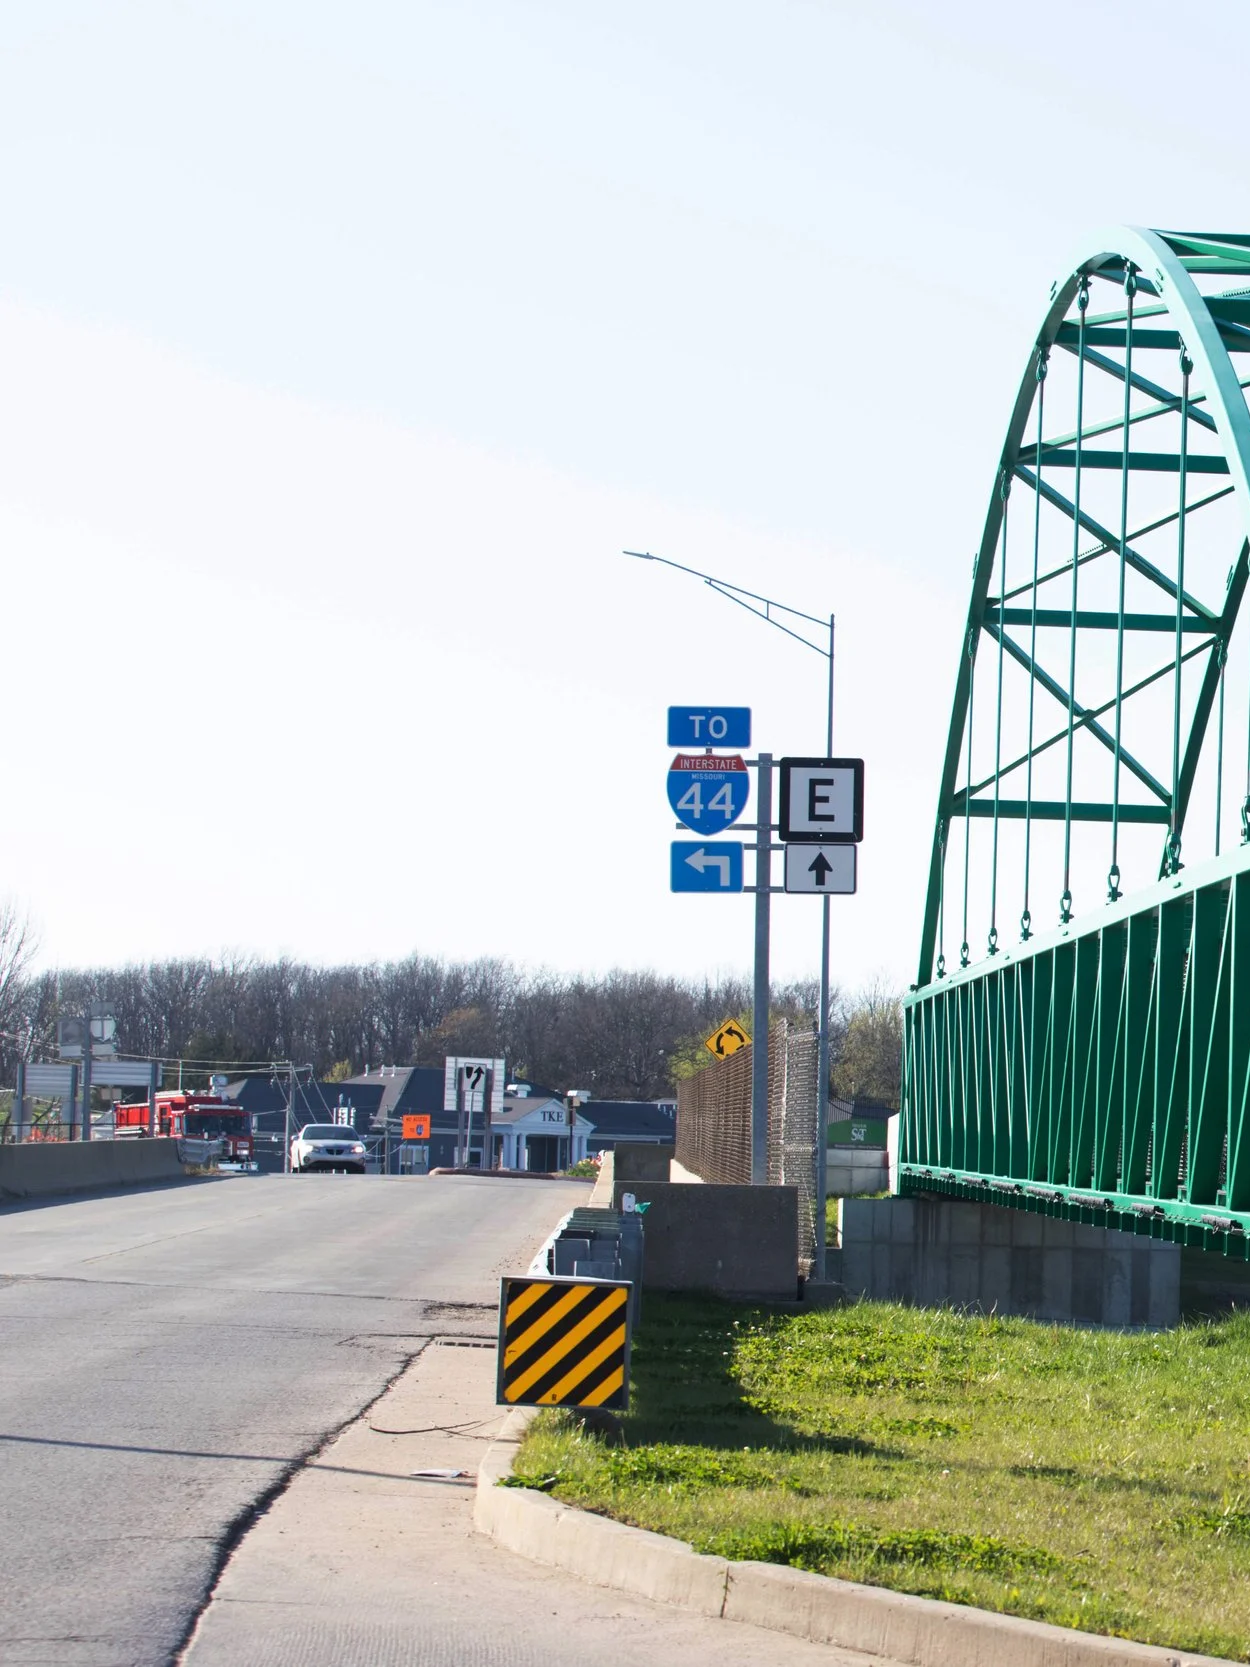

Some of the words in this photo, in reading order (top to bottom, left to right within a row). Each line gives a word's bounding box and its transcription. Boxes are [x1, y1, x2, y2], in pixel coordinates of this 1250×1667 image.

[689, 715, 728, 739] TO
[680, 758, 737, 770] INTERSTATE
[691, 772, 726, 781] MISSOURI
[676, 782, 735, 820] 44
[808, 778, 835, 822] E
[541, 1110, 564, 1122] TKE
